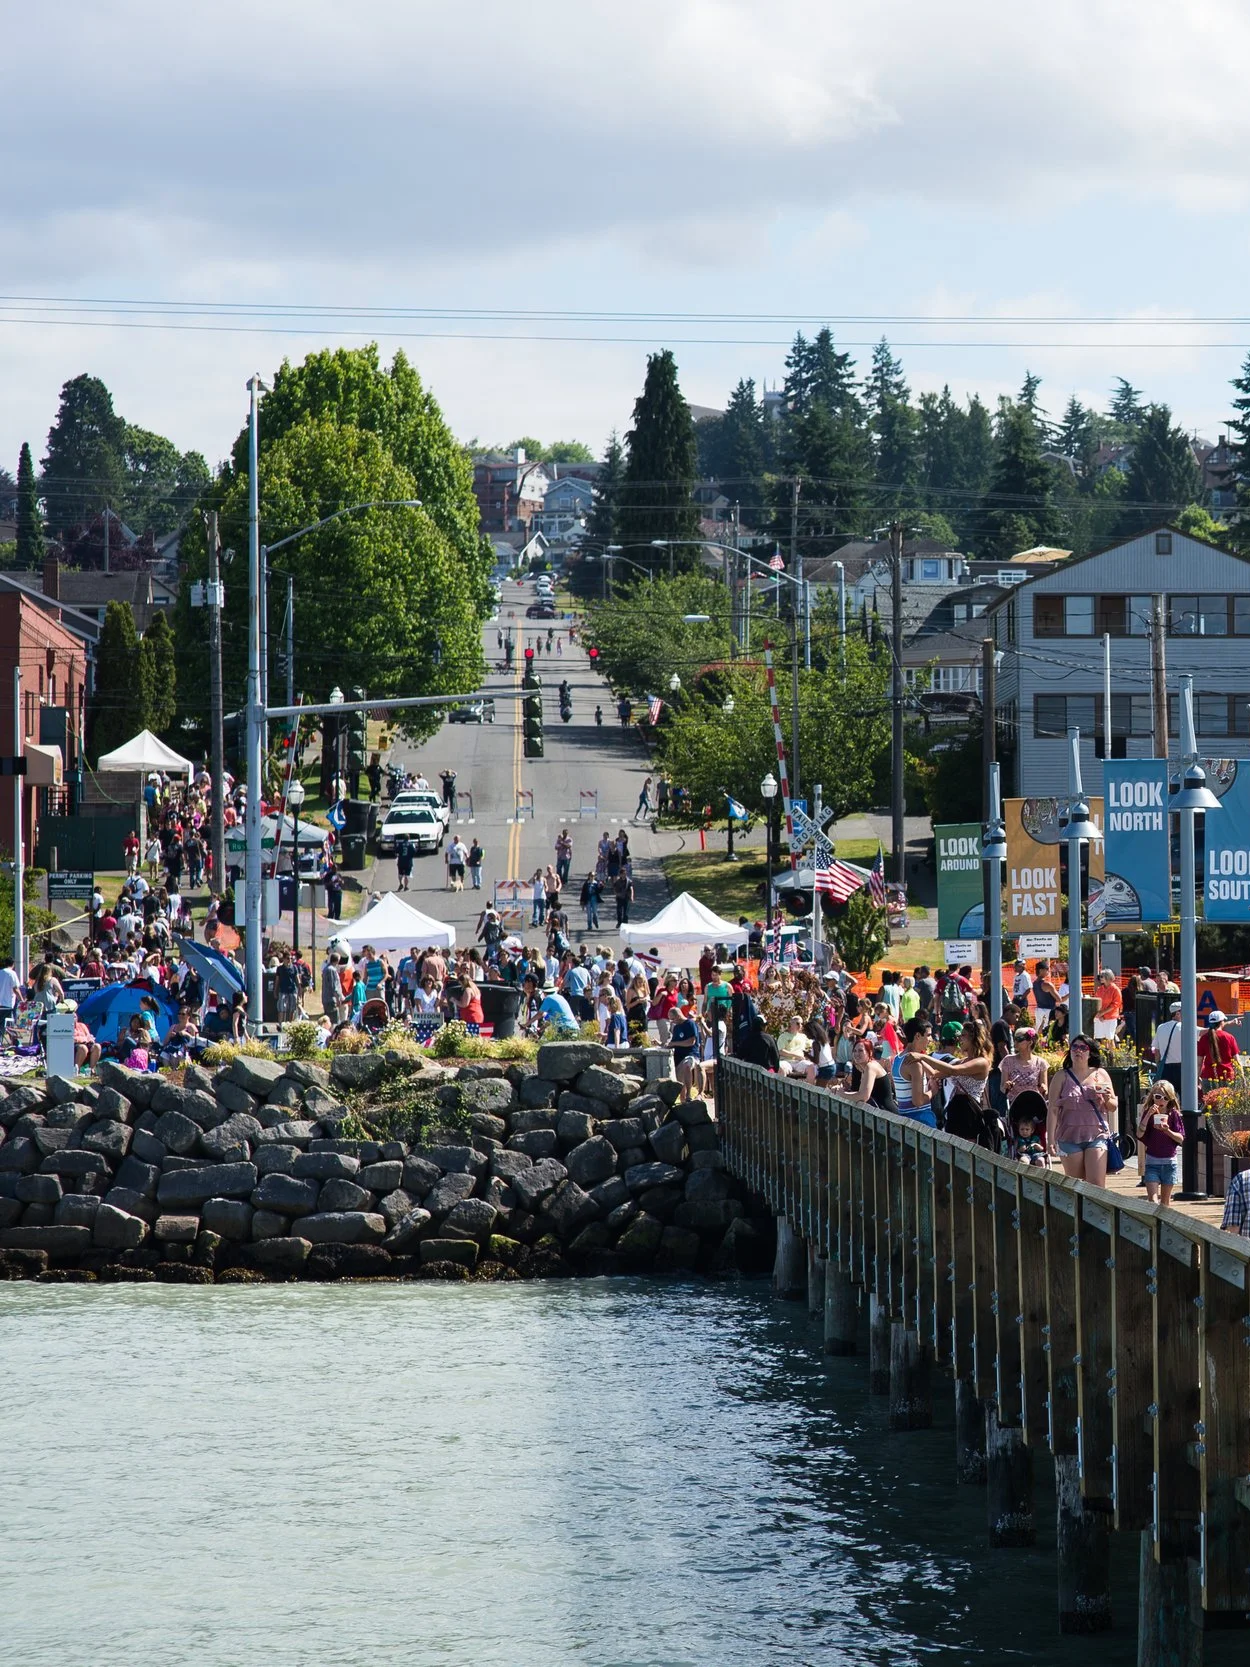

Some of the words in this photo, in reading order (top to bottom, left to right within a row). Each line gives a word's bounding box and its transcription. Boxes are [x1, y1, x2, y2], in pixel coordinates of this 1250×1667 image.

[1109, 781, 1164, 808] LOOK
[791, 807, 832, 850] CROSSING
[791, 808, 832, 850] RAILROAD
[1109, 812, 1163, 831] NORTH
[940, 837, 980, 857] LOOK
[797, 861, 816, 869] TRAC
[940, 858, 980, 871] AROUND
[1011, 867, 1057, 890] LOOK
[1011, 892, 1058, 917] FAST
